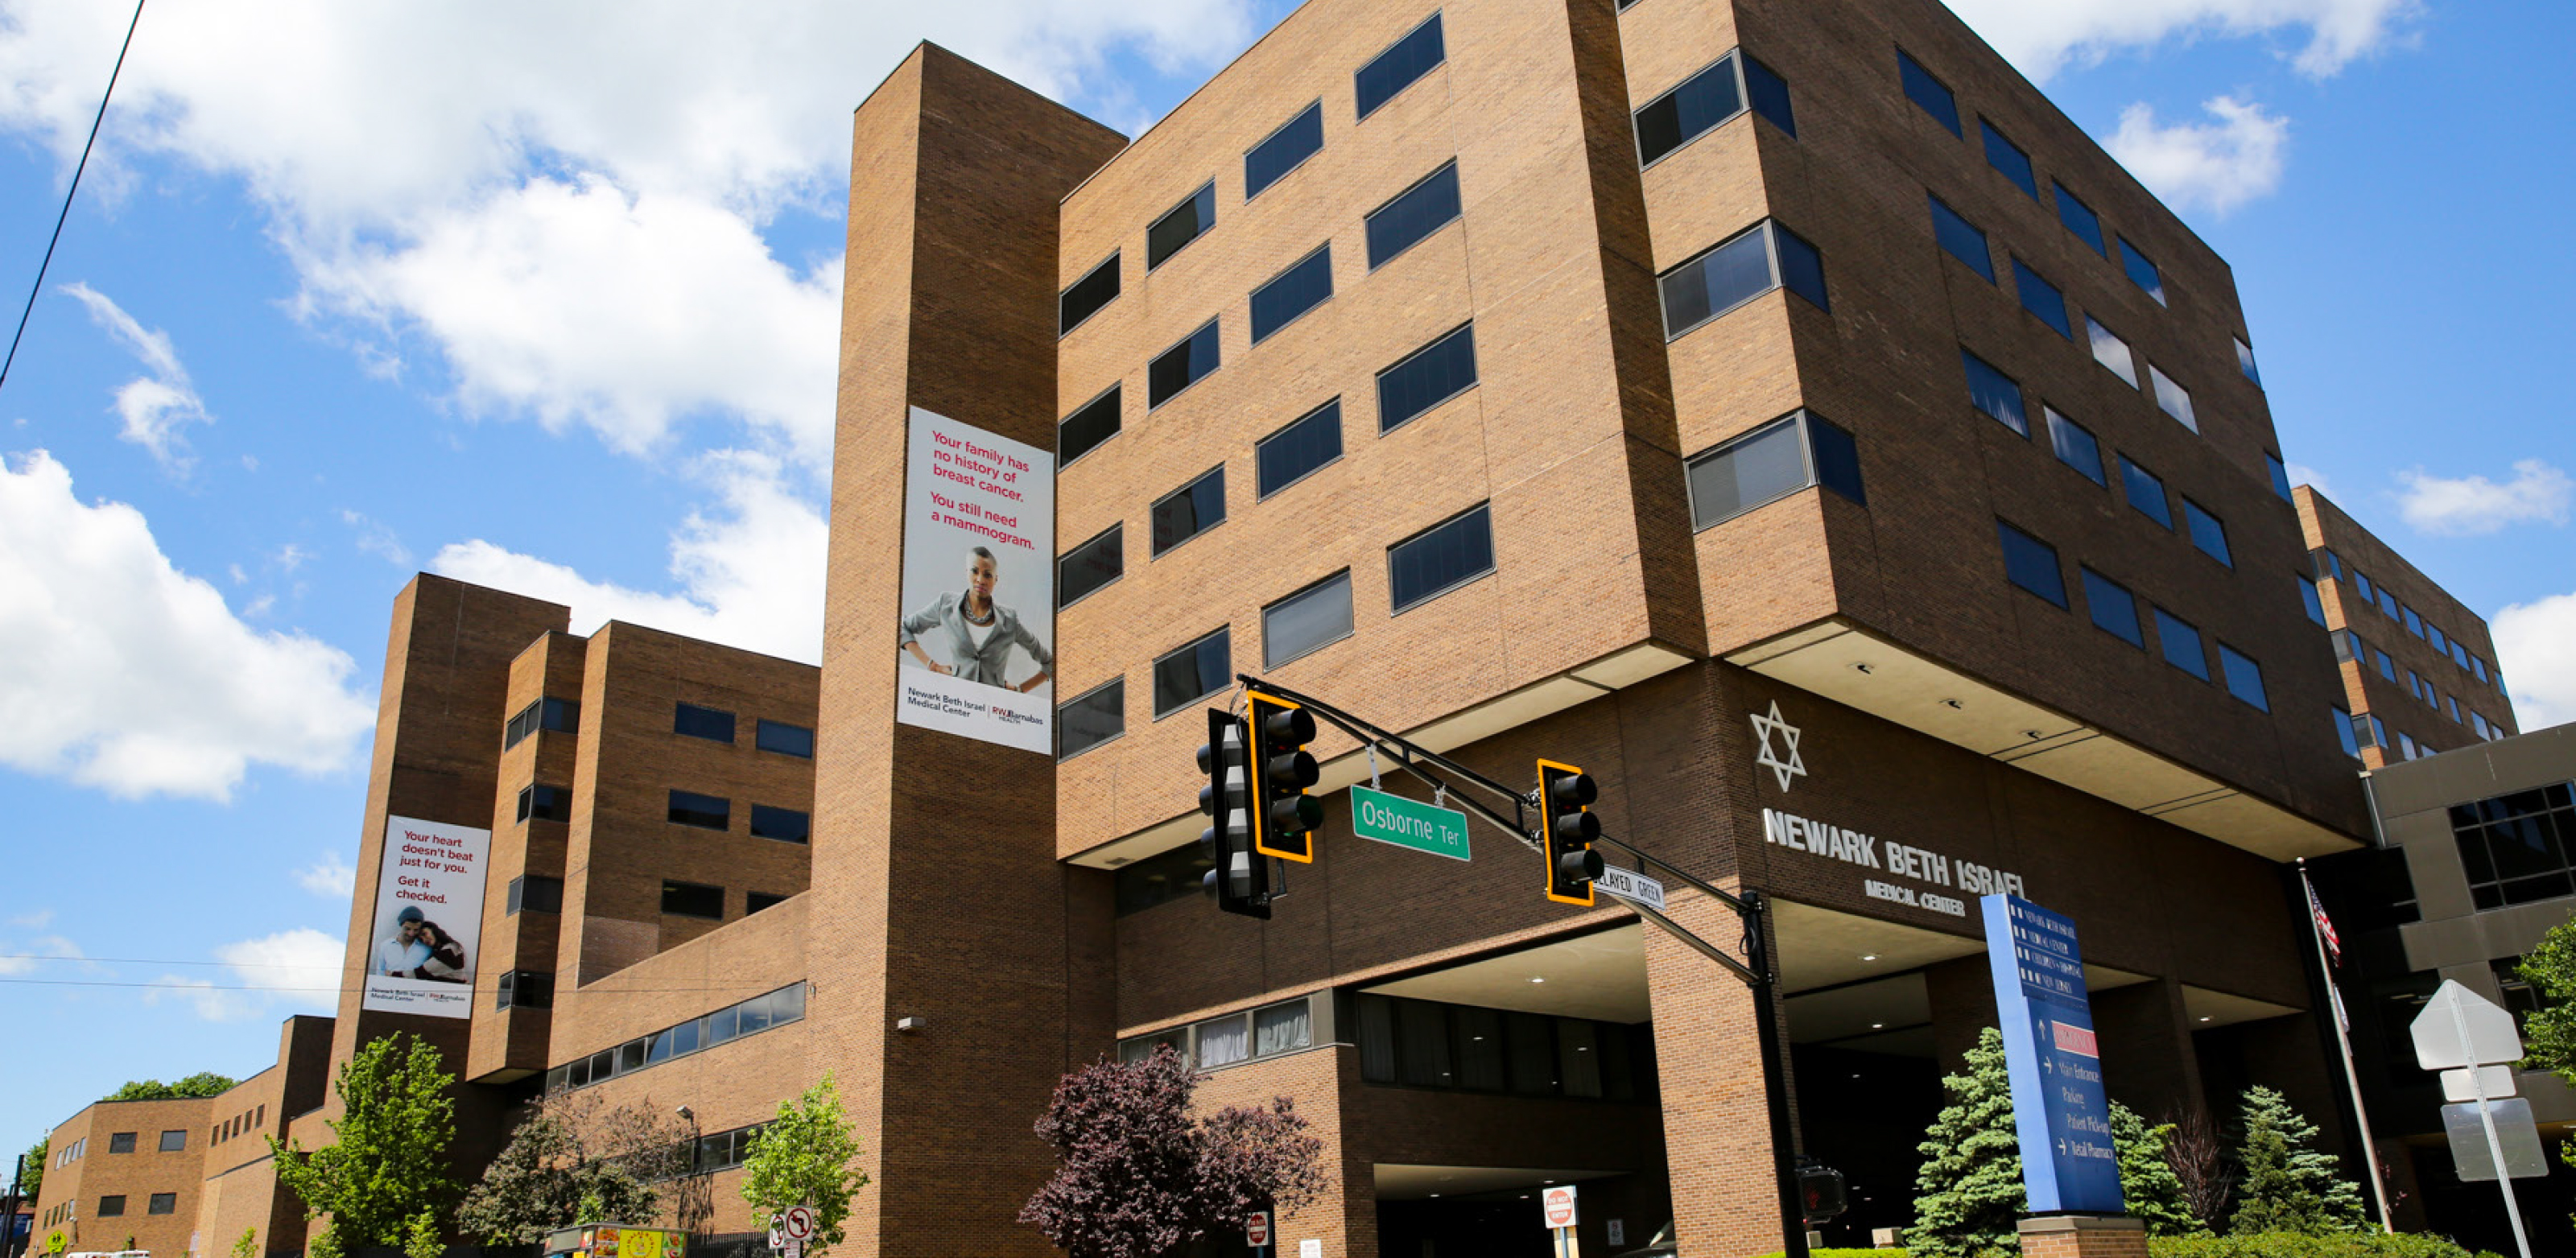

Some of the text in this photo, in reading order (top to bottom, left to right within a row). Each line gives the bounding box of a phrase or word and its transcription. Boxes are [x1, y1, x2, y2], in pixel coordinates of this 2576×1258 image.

[932, 431, 1030, 472] Your family has
[934, 449, 1017, 483] no history of
[933, 464, 1024, 502] breast cancer.
[931, 491, 1017, 528] You still need
[931, 511, 1035, 551] a mammogram.
[907, 696, 971, 718] Medical Center
[908, 687, 986, 711] Newark Beth Israel
[1362, 801, 1459, 846] Osborne Ter
[405, 830, 462, 848] Your heart
[1763, 807, 1880, 869] NEWARK
[1885, 841, 1951, 886] BETH
[399, 855, 468, 873] just for you.
[402, 843, 473, 861] doesn't beat
[398, 875, 430, 889] Get it
[1638, 880, 1662, 903] GREEN
[396, 889, 447, 904] checked.
[1864, 880, 1965, 917] MEDICAL CENTER
[2062, 1087, 2085, 1109] Parking
